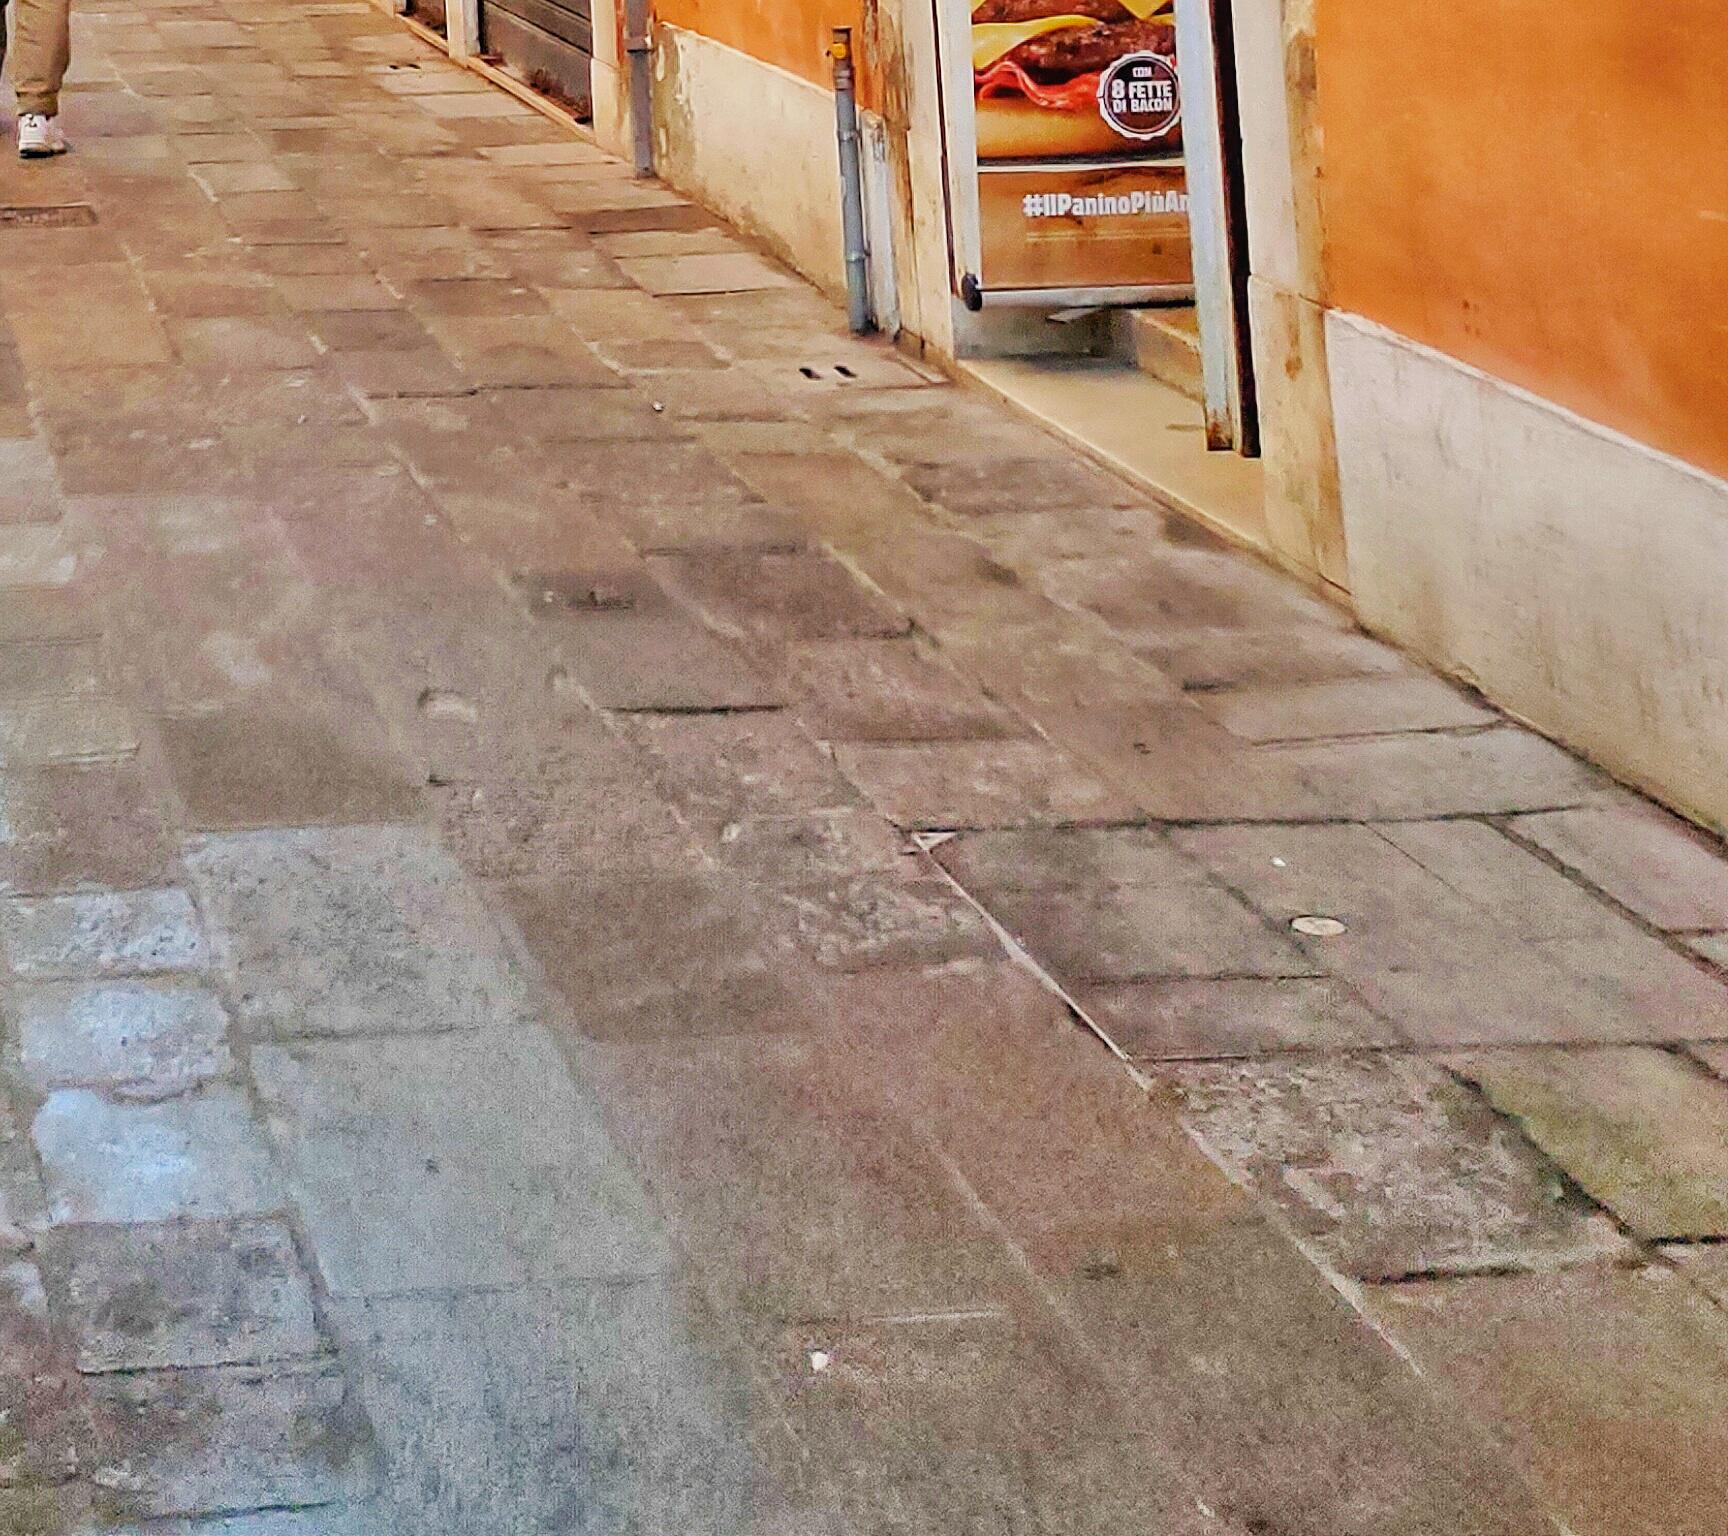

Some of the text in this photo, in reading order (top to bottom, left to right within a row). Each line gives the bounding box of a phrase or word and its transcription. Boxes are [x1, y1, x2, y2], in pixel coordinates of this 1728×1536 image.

[1133, 66, 1152, 78] CON
[1112, 79, 1172, 99] 8 FETTE
[1113, 97, 1173, 113] DI BACON
